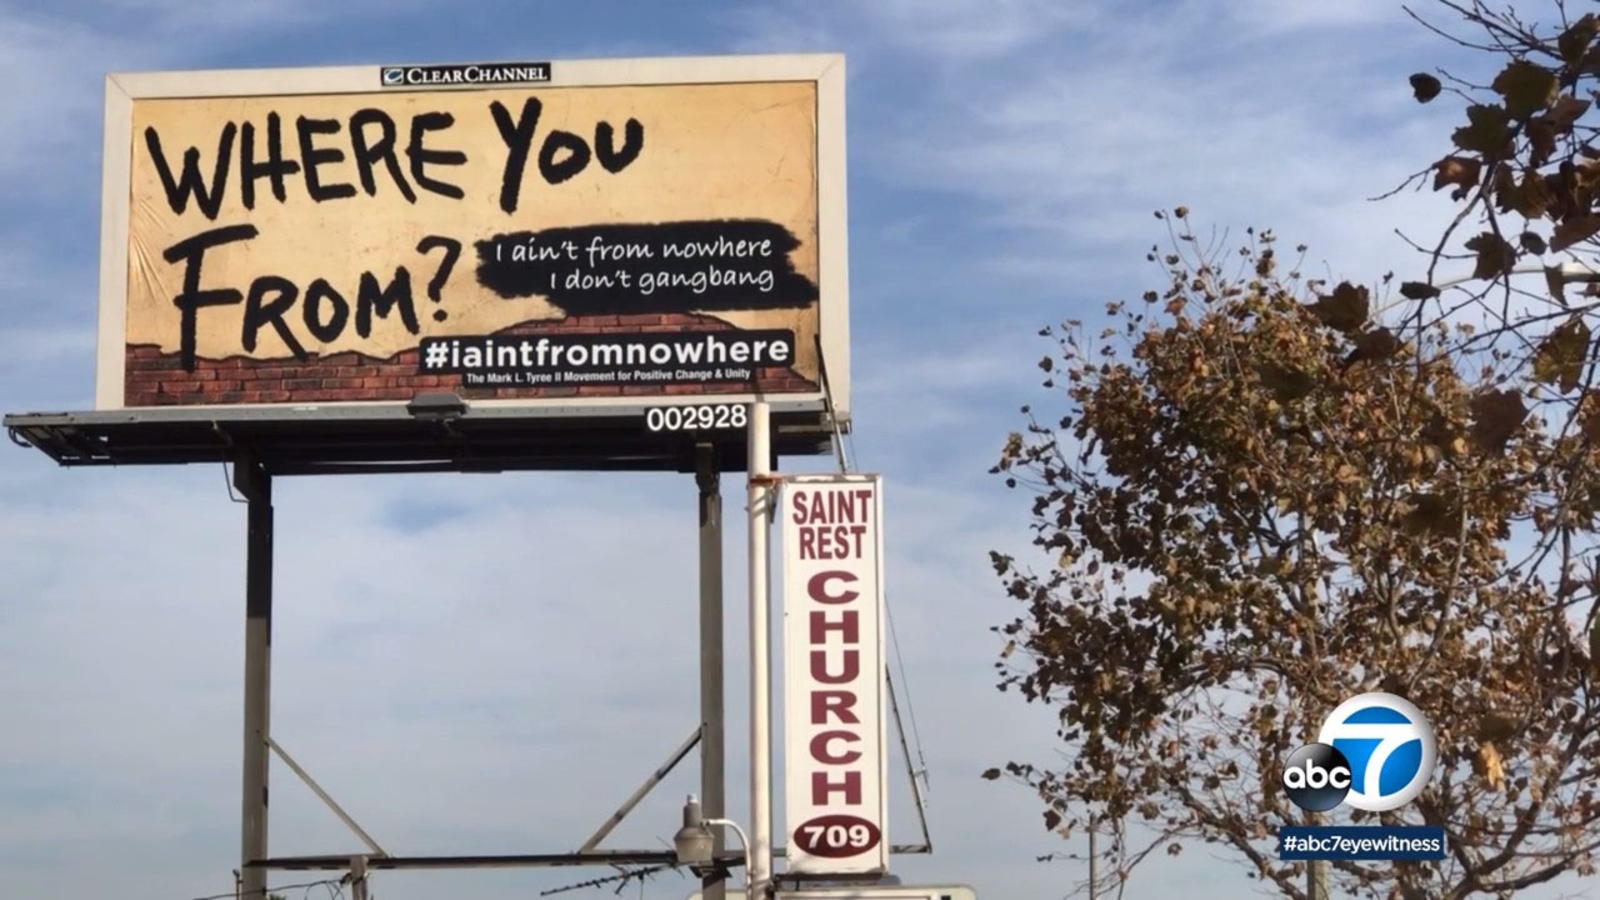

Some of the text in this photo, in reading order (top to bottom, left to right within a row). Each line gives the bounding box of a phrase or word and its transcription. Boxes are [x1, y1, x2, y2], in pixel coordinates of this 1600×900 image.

[144, 96, 644, 220] WHERE YOU
[496, 235, 772, 267] I ain't from nowhere
[550, 264, 774, 294] I don't gangbang
[162, 223, 462, 373] FROM?
[425, 335, 790, 369] #iaintfromnowhere
[467, 373, 485, 383] The
[487, 373, 513, 383] Mark
[515, 373, 524, 382] L.
[525, 372, 553, 384] Tyree
[564, 371, 615, 381] Movement
[617, 370, 632, 380] for
[634, 370, 673, 380] Positive
[675, 369, 712, 381] Change
[714, 369, 722, 378] &
[725, 368, 751, 379] Unity
[646, 404, 747, 431] 002928
[792, 490, 872, 525] SAINT
[799, 526, 866, 560] REST
[807, 570, 863, 806] CHURCH
[803, 826, 870, 848] 709
